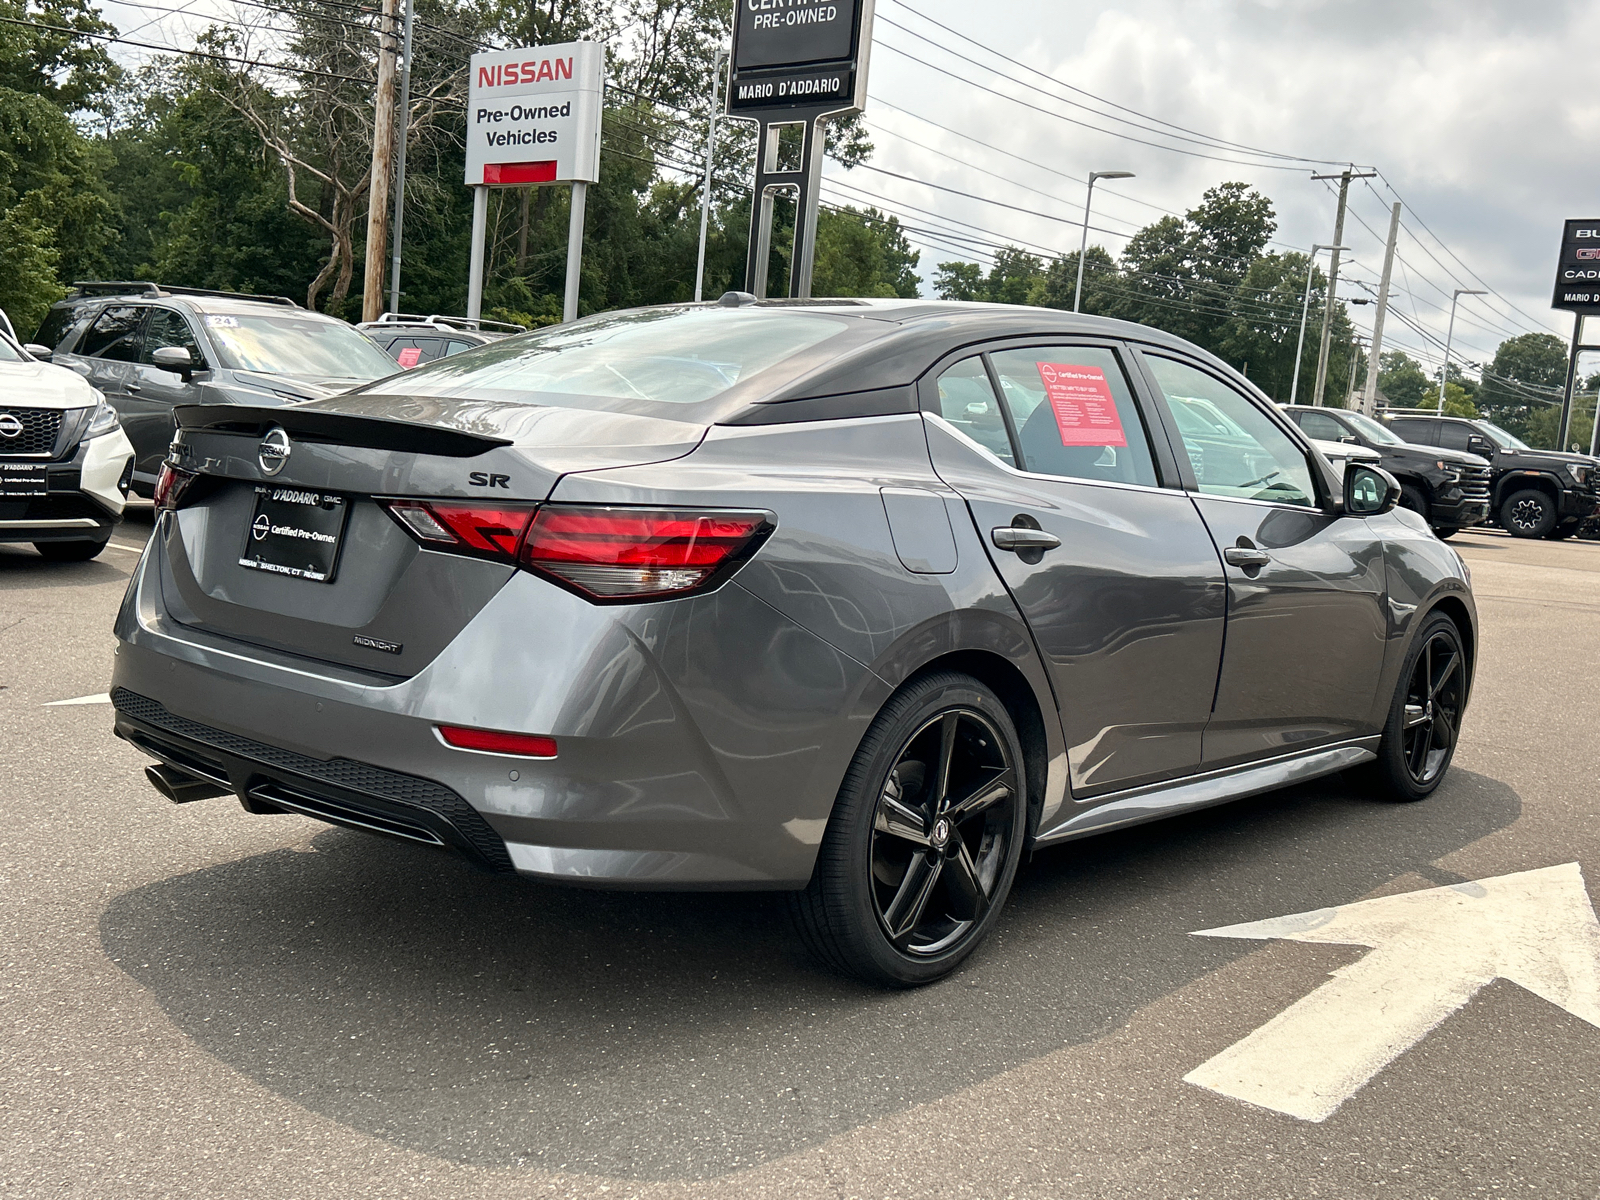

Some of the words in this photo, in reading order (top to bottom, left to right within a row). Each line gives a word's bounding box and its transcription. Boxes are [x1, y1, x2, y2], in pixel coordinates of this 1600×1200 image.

[754, 6, 837, 30] PRE-OWNED
[478, 57, 573, 88] NISSAN
[738, 83, 773, 100] MARIO
[778, 77, 840, 96] D'ADDARIO
[477, 101, 571, 124] Pre-Owned
[486, 128, 558, 147] Vehicles
[1576, 248, 1600, 260] G
[1564, 293, 1590, 302] MARIO
[214, 317, 231, 325] 24
[1058, 371, 1078, 379] Certified
[1078, 373, 1104, 381] Pre-Owned
[468, 471, 511, 489] SR
[323, 495, 342, 504] GMC
[271, 525, 298, 537] Certified
[260, 562, 290, 575] SHELTON,
[291, 568, 301, 576] CT
[353, 636, 398, 652] MIDNIGHT
